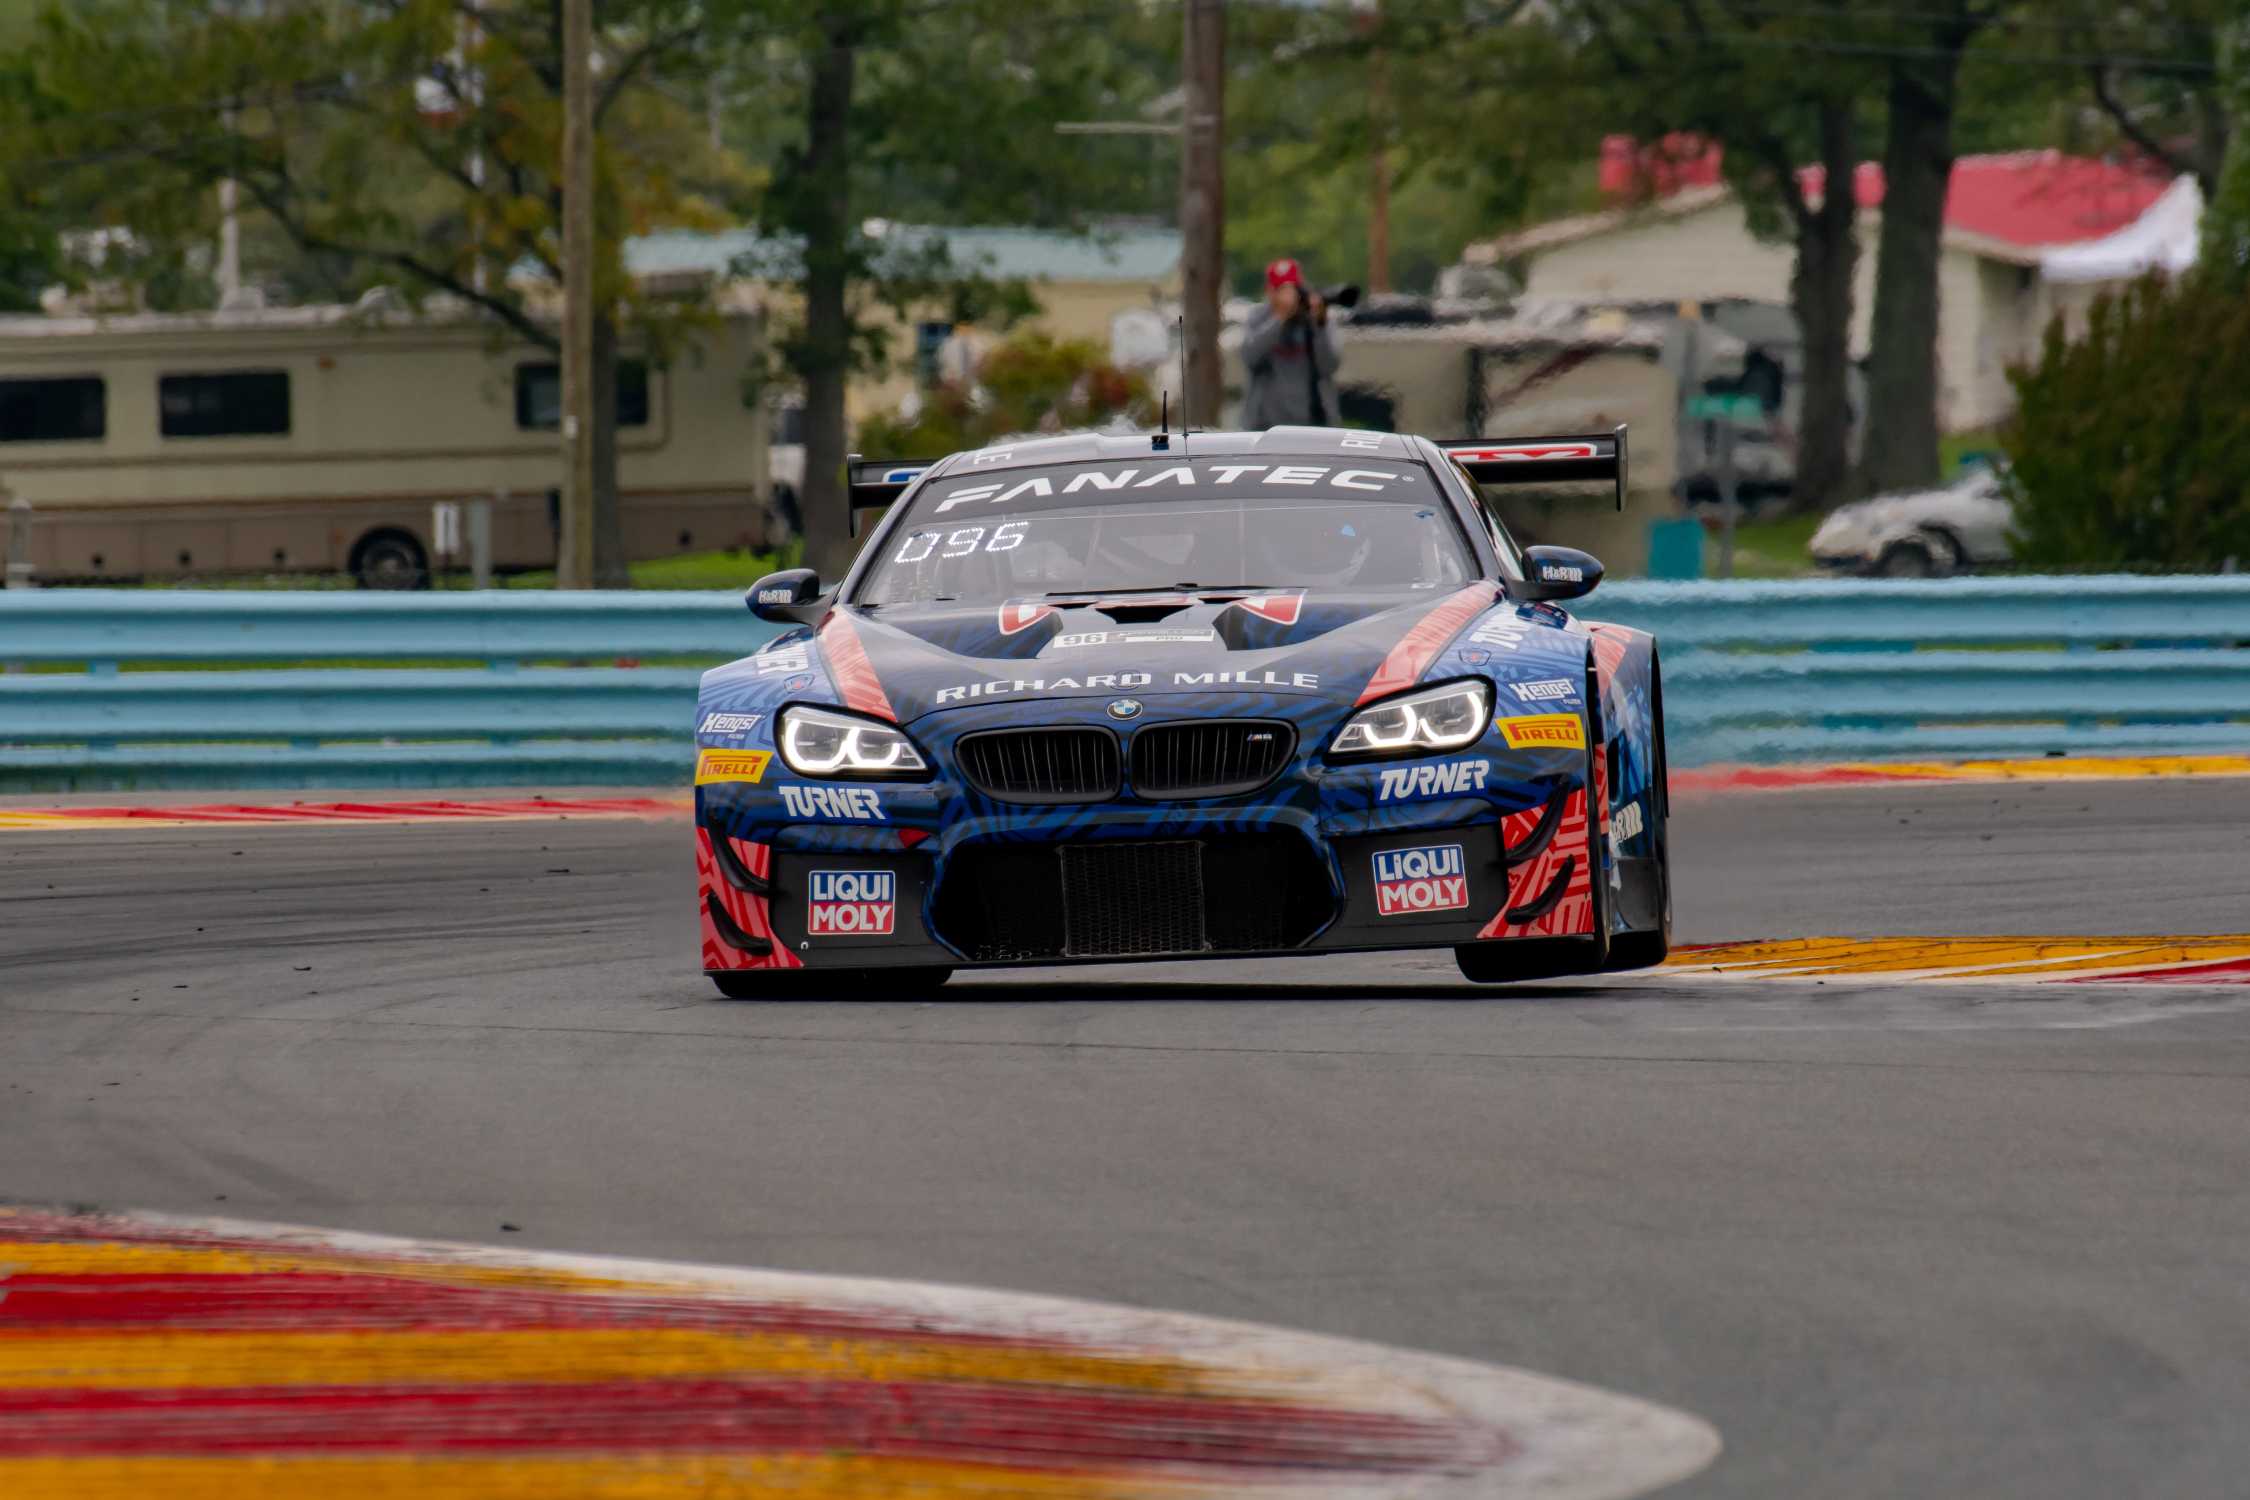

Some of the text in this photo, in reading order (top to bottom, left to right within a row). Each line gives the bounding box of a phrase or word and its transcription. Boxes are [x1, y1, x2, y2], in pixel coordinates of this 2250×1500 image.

[934, 464, 1398, 513] FANATEC
[894, 520, 1029, 563] 096
[1063, 633, 1103, 646] 96
[936, 671, 1320, 704] RICHARD MILLE
[1508, 678, 1577, 701] Hengst
[699, 712, 763, 733] Hengst
[1508, 720, 1579, 742] PIRELLI
[701, 755, 763, 777] PIRELLI
[1379, 759, 1490, 801] TURNER
[778, 785, 887, 820] TURNER
[1378, 848, 1459, 881] LIQUI
[813, 873, 890, 902] LIQUI
[1381, 878, 1465, 911] MOLY
[812, 904, 892, 931] MOLY
